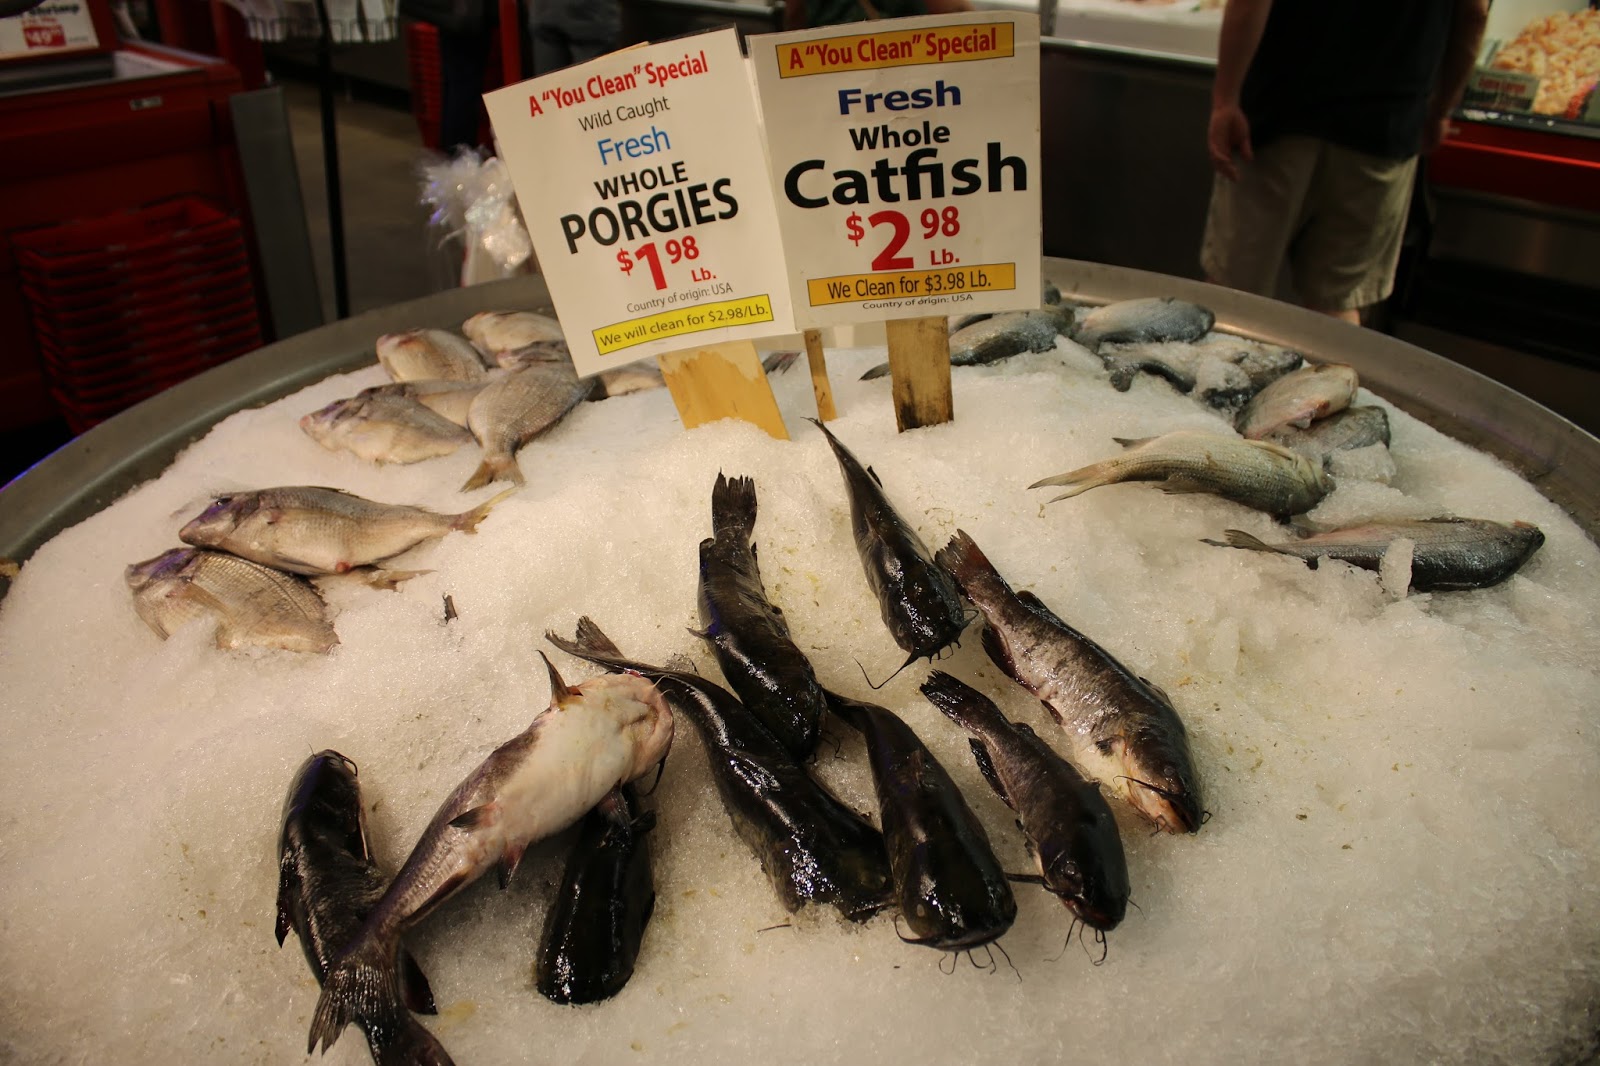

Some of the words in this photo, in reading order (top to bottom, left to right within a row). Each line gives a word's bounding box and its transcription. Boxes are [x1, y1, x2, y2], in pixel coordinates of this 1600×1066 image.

[790, 49, 804, 70] A
[926, 27, 997, 61] Special
[528, 96, 544, 117] A
[644, 50, 708, 87] Special
[838, 80, 962, 115] Fresh
[578, 110, 613, 132] Wild
[616, 96, 671, 122] Caught
[597, 126, 671, 166] Fresh
[849, 121, 951, 151] Whole
[593, 161, 688, 200] WHOLE
[784, 142, 1027, 209] Catfish
[560, 178, 739, 255] PORGIES
[691, 267, 717, 283] Lb.
[930, 249, 960, 266] Lb.
[626, 295, 666, 313] Country
[667, 293, 678, 304] of
[679, 287, 711, 303] origin:
[711, 282, 734, 296] USA
[827, 281, 851, 299] We
[855, 278, 896, 297] Clean
[899, 276, 920, 294] for
[924, 271, 966, 294] $3.98
[970, 269, 992, 288] Lb.
[862, 299, 903, 310] Country
[905, 298, 916, 307] of
[918, 295, 950, 307] origin:
[951, 293, 974, 303] USA
[599, 332, 622, 348] We
[624, 325, 647, 342] will
[649, 319, 684, 335] clean
[687, 313, 705, 327] for
[708, 303, 769, 323] $2.98/Lb.
